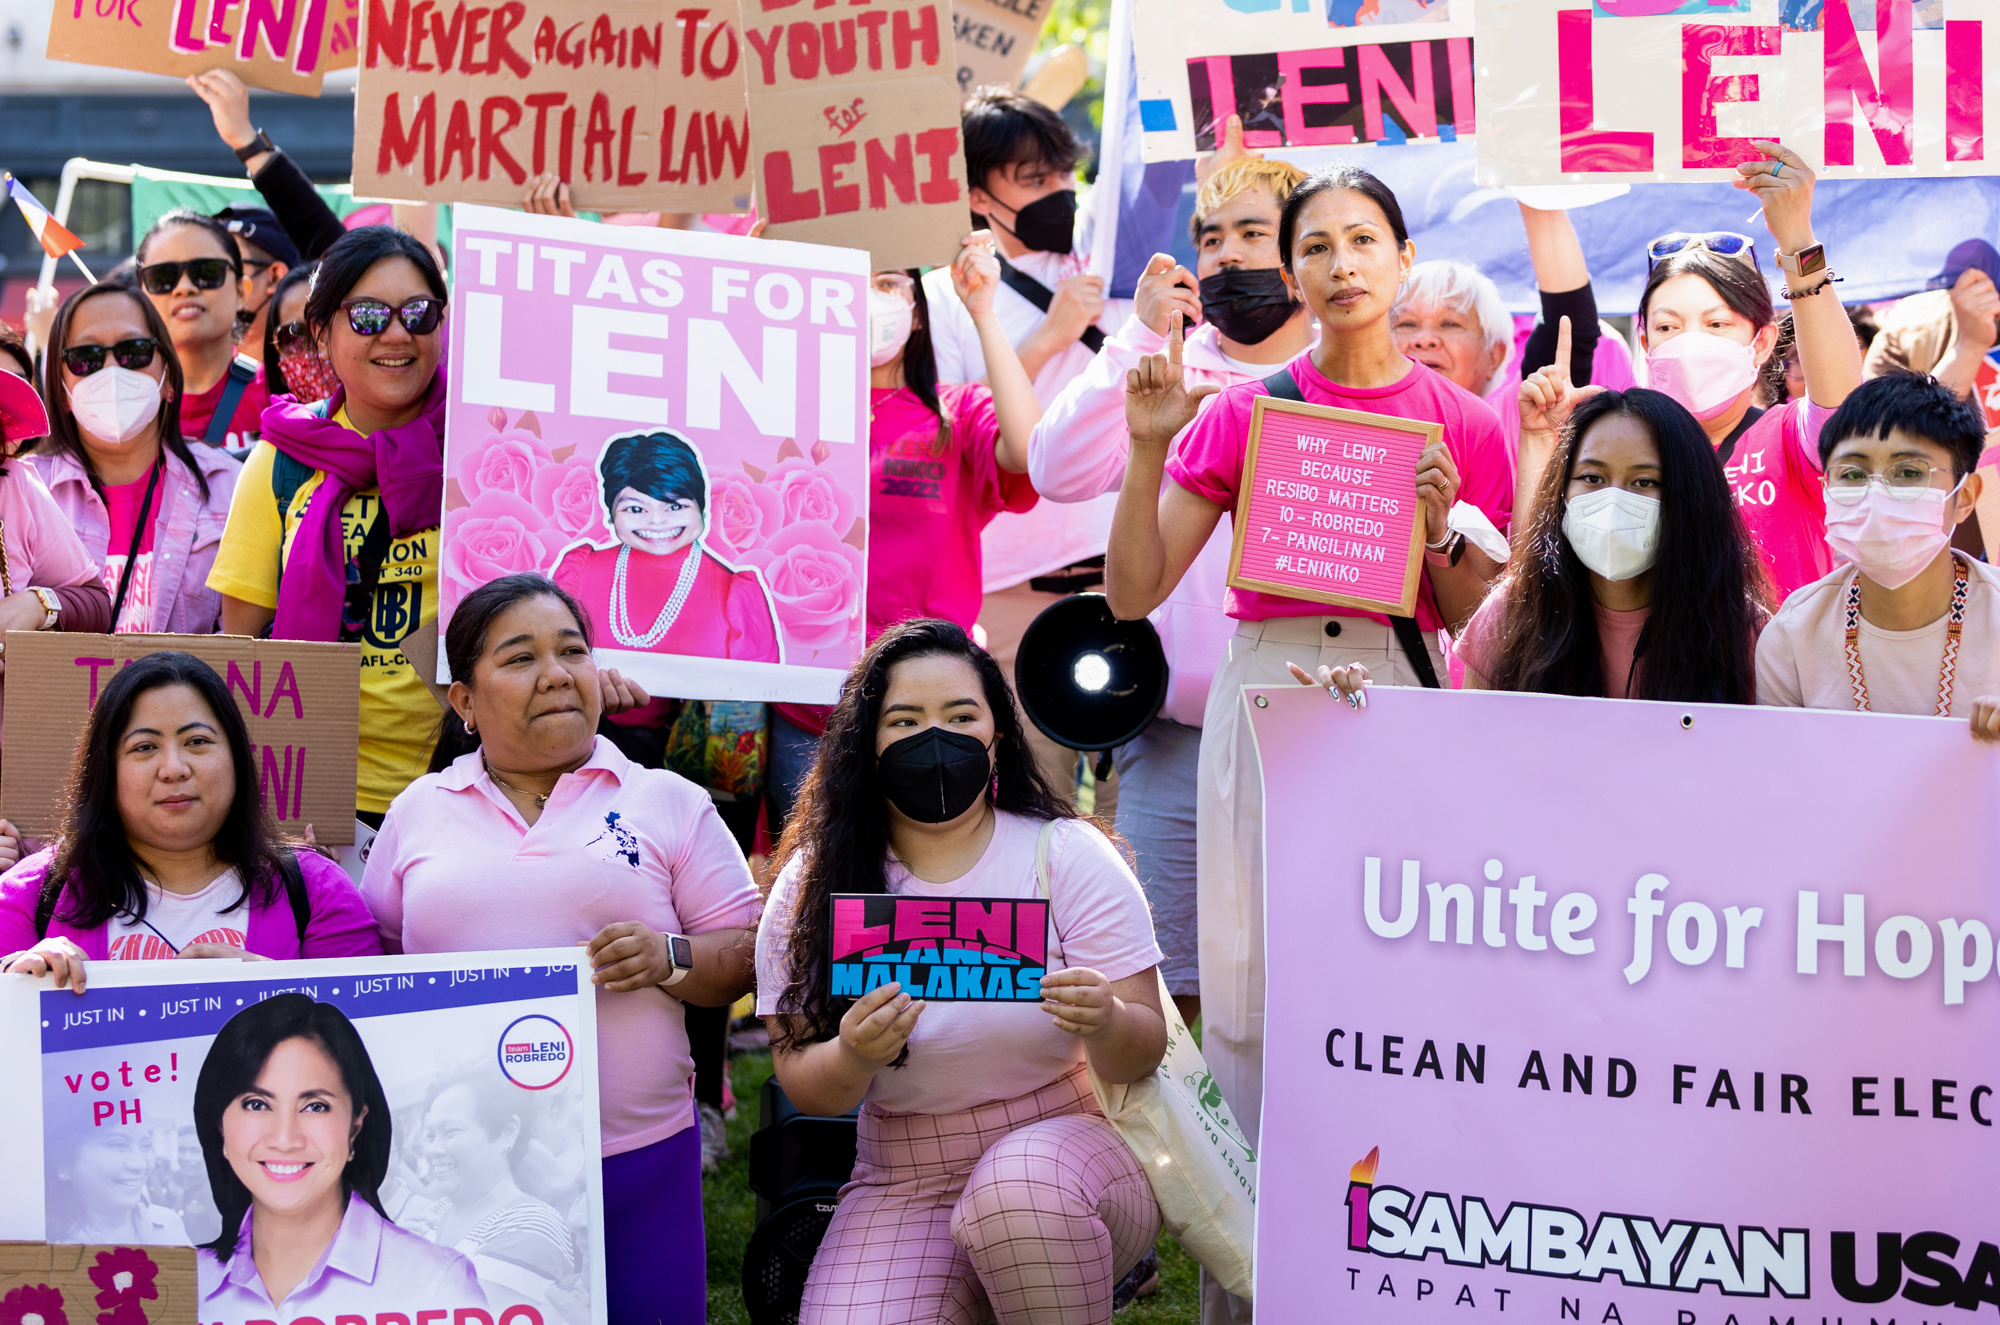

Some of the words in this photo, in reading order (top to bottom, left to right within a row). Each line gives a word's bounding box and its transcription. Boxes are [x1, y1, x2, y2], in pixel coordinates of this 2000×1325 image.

[365, 0, 532, 80] NEVER
[532, 13, 663, 70] AGAIN
[675, 8, 740, 81] TO
[745, 4, 941, 86] YOUTH
[1205, 36, 1476, 151] LENI
[1557, 0, 1985, 174] LENI
[376, 90, 648, 187] MARTIAL
[658, 104, 750, 186] LAW
[764, 126, 961, 225] LENI
[465, 237, 685, 308] TITAS
[711, 266, 858, 328] FOR
[462, 291, 857, 445] LENI
[1297, 434, 1330, 455] WHY
[1342, 442, 1387, 465] LENI?
[1301, 460, 1374, 487] BECAUSE
[1266, 479, 1319, 502] RESIBO
[1328, 489, 1399, 516] MATTERS
[1287, 532, 1386, 563] PANGILINAN
[1312, 511, 1384, 538] ROBREDO
[394, 565, 423, 578] 340
[1275, 555, 1360, 583] #LENIKIKO
[832, 898, 1047, 967] LENI
[862, 938, 1021, 966] LANG
[1362, 856, 1599, 957] Unite
[1622, 873, 1765, 986] for
[1796, 890, 2000, 1005] Hop
[63, 1010, 104, 1030] JUST
[107, 1006, 125, 1023] IN
[161, 999, 201, 1020] JUST
[204, 996, 222, 1012] IN
[354, 978, 395, 999] JUST
[397, 974, 415, 990] IN
[831, 963, 1046, 999] MALAKAS
[505, 1052, 566, 1064] ROBREDO
[507, 1045, 529, 1053] team
[531, 1041, 565, 1053] LENI
[64, 1052, 180, 1095] vote!
[1325, 1027, 1487, 1085] CLEAN
[1518, 1050, 1638, 1099] AND
[1672, 1064, 1813, 1116] FAIR
[1852, 1076, 1993, 1126] ELEC
[93, 1098, 143, 1127] PH
[1346, 1267, 1511, 1313] TAPAT
[1560, 1296, 1624, 1325] NA
